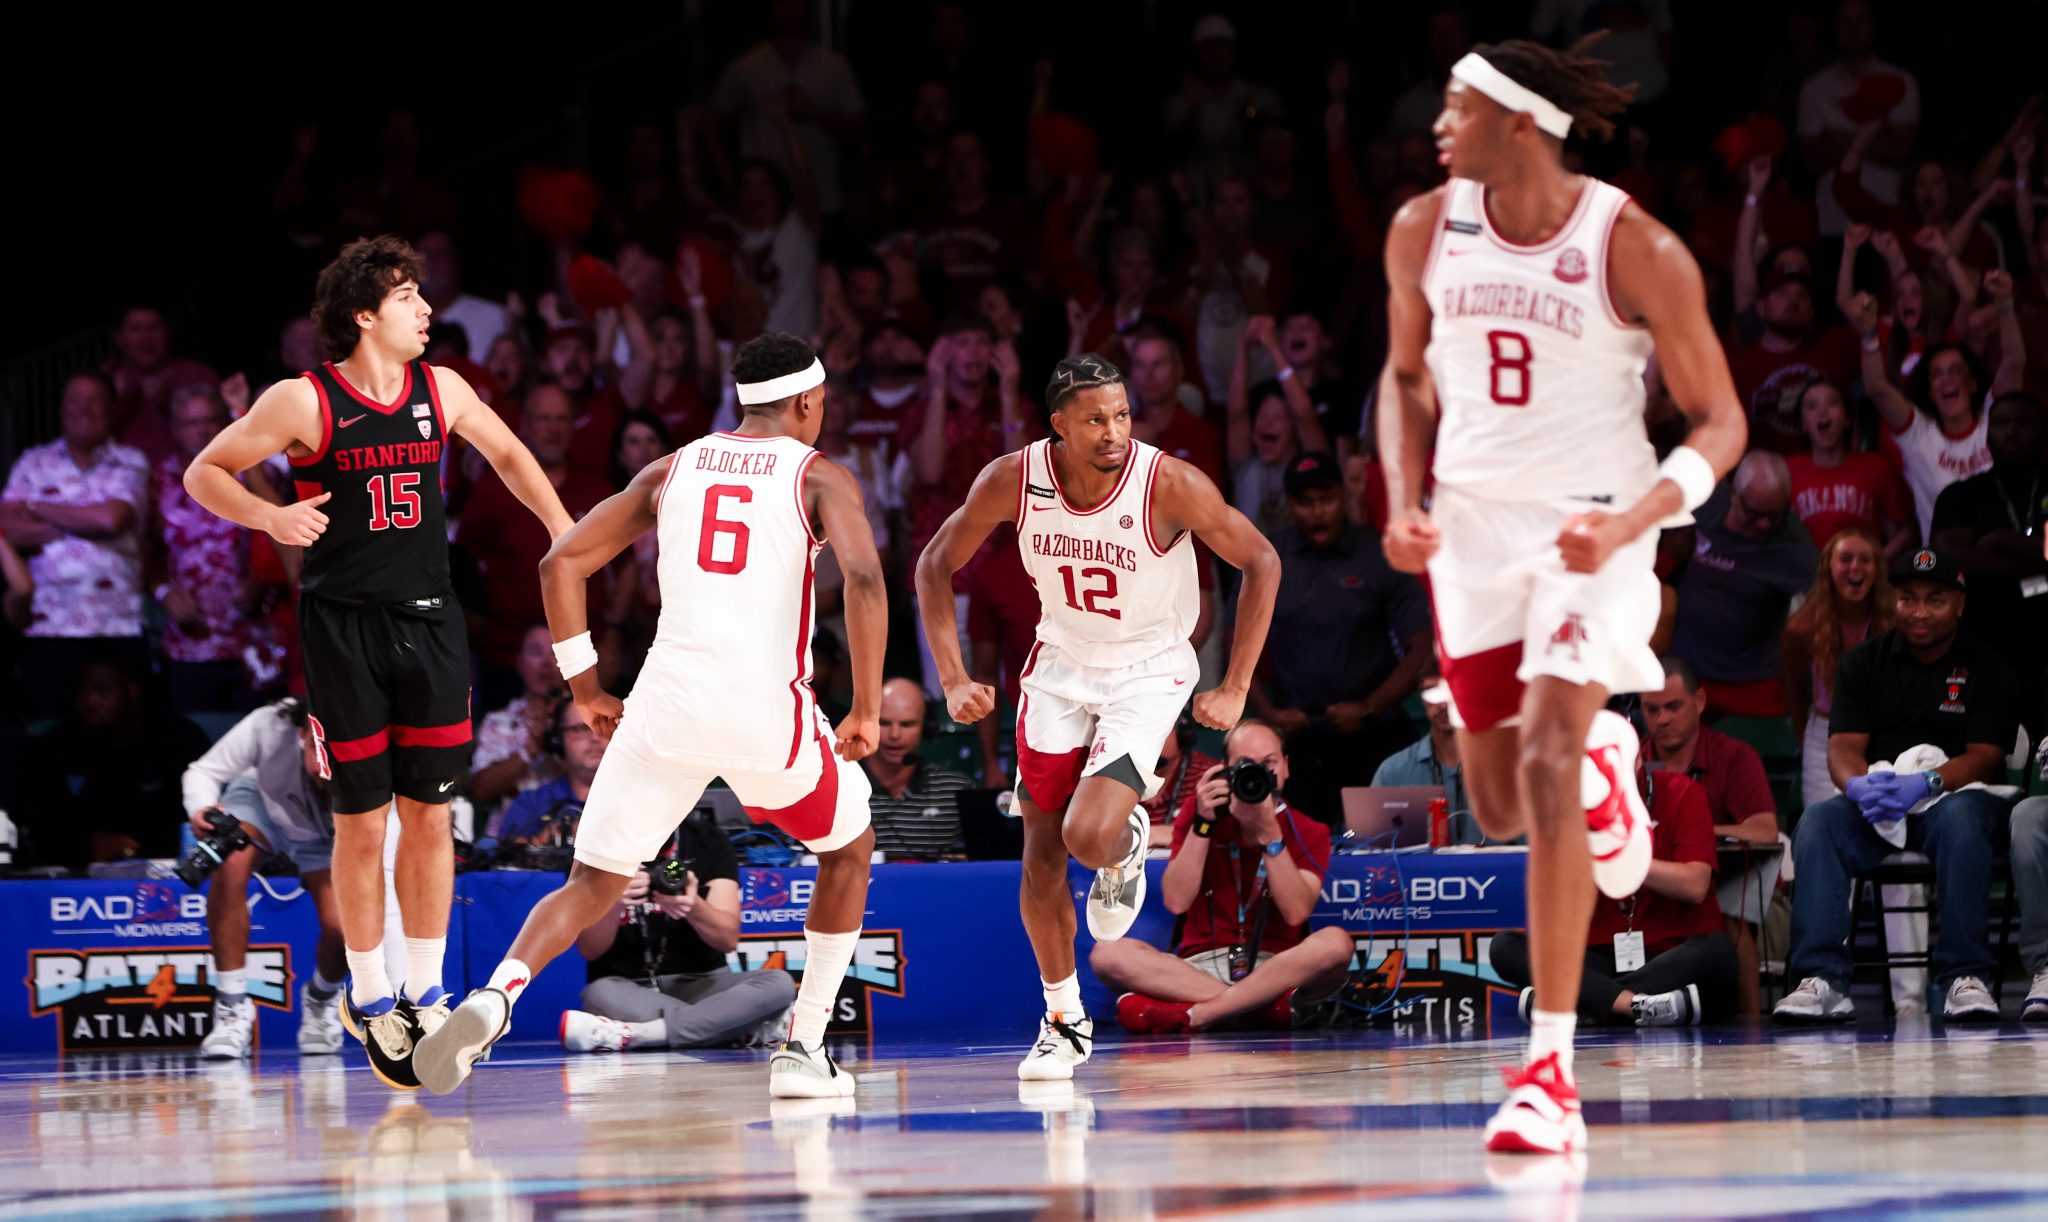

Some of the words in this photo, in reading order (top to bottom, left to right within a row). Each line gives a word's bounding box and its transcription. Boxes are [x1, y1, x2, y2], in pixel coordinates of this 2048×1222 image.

[1445, 282, 1585, 339] RAZORBACKS
[1487, 330, 1534, 407] 8
[335, 440, 441, 471] STANFORD
[696, 447, 778, 476] BLOCKER
[366, 472, 422, 531] 15
[697, 483, 754, 575] 6
[1032, 533, 1136, 572] RAZORBACKS
[1057, 565, 1121, 620] 12
[1411, 876, 1497, 901] BOY
[51, 896, 134, 921] BAD
[741, 910, 807, 923] OWERS
[1342, 906, 1432, 921] MOWERS
[114, 922, 202, 937] MOWERS
[35, 952, 284, 1008] BATTE
[145, 965, 176, 1010] 4
[73, 1012, 209, 1039] ATLANT
